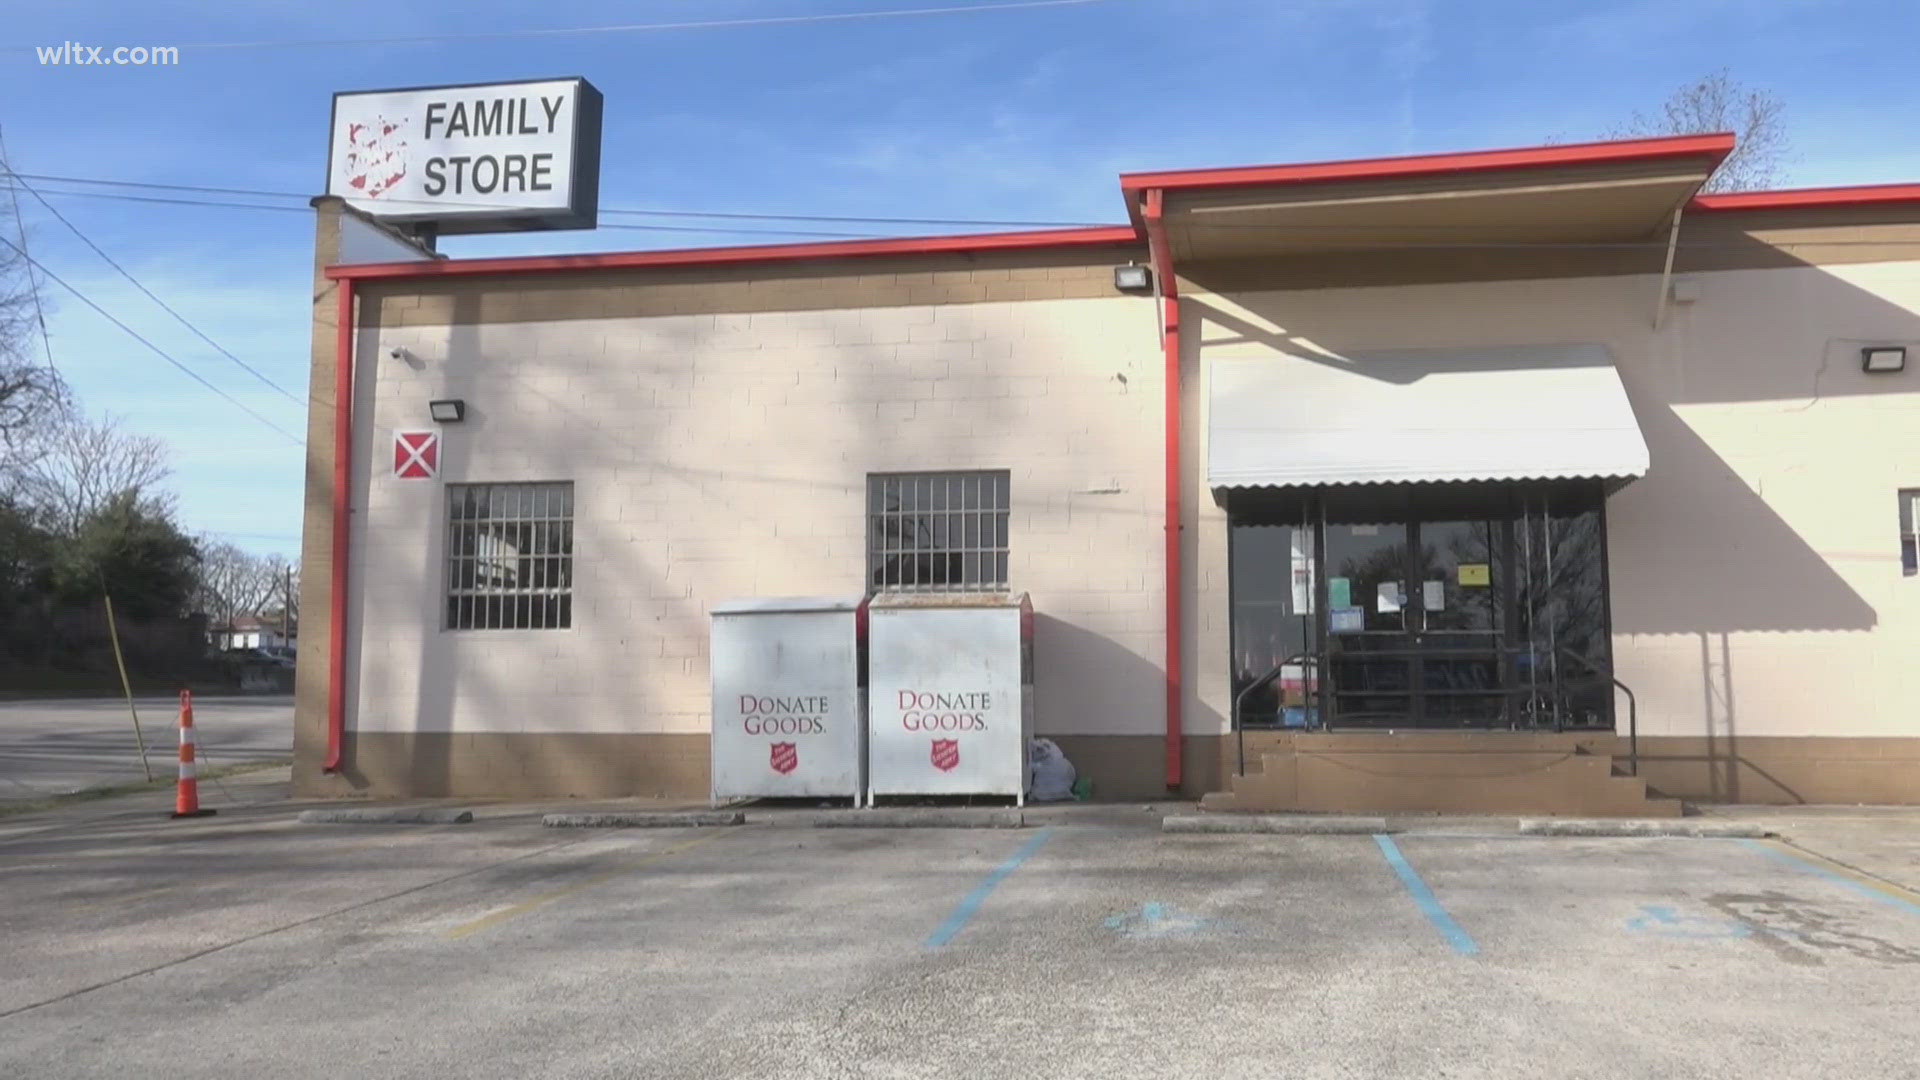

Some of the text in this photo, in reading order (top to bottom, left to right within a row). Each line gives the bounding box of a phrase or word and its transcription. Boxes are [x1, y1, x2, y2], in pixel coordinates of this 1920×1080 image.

[425, 96, 564, 139] FAMILY
[424, 154, 553, 196] STORE
[740, 694, 828, 714] DONATE
[899, 690, 990, 710] DONATE
[744, 715, 826, 735] GOODS.
[903, 710, 988, 731] GOODS.
